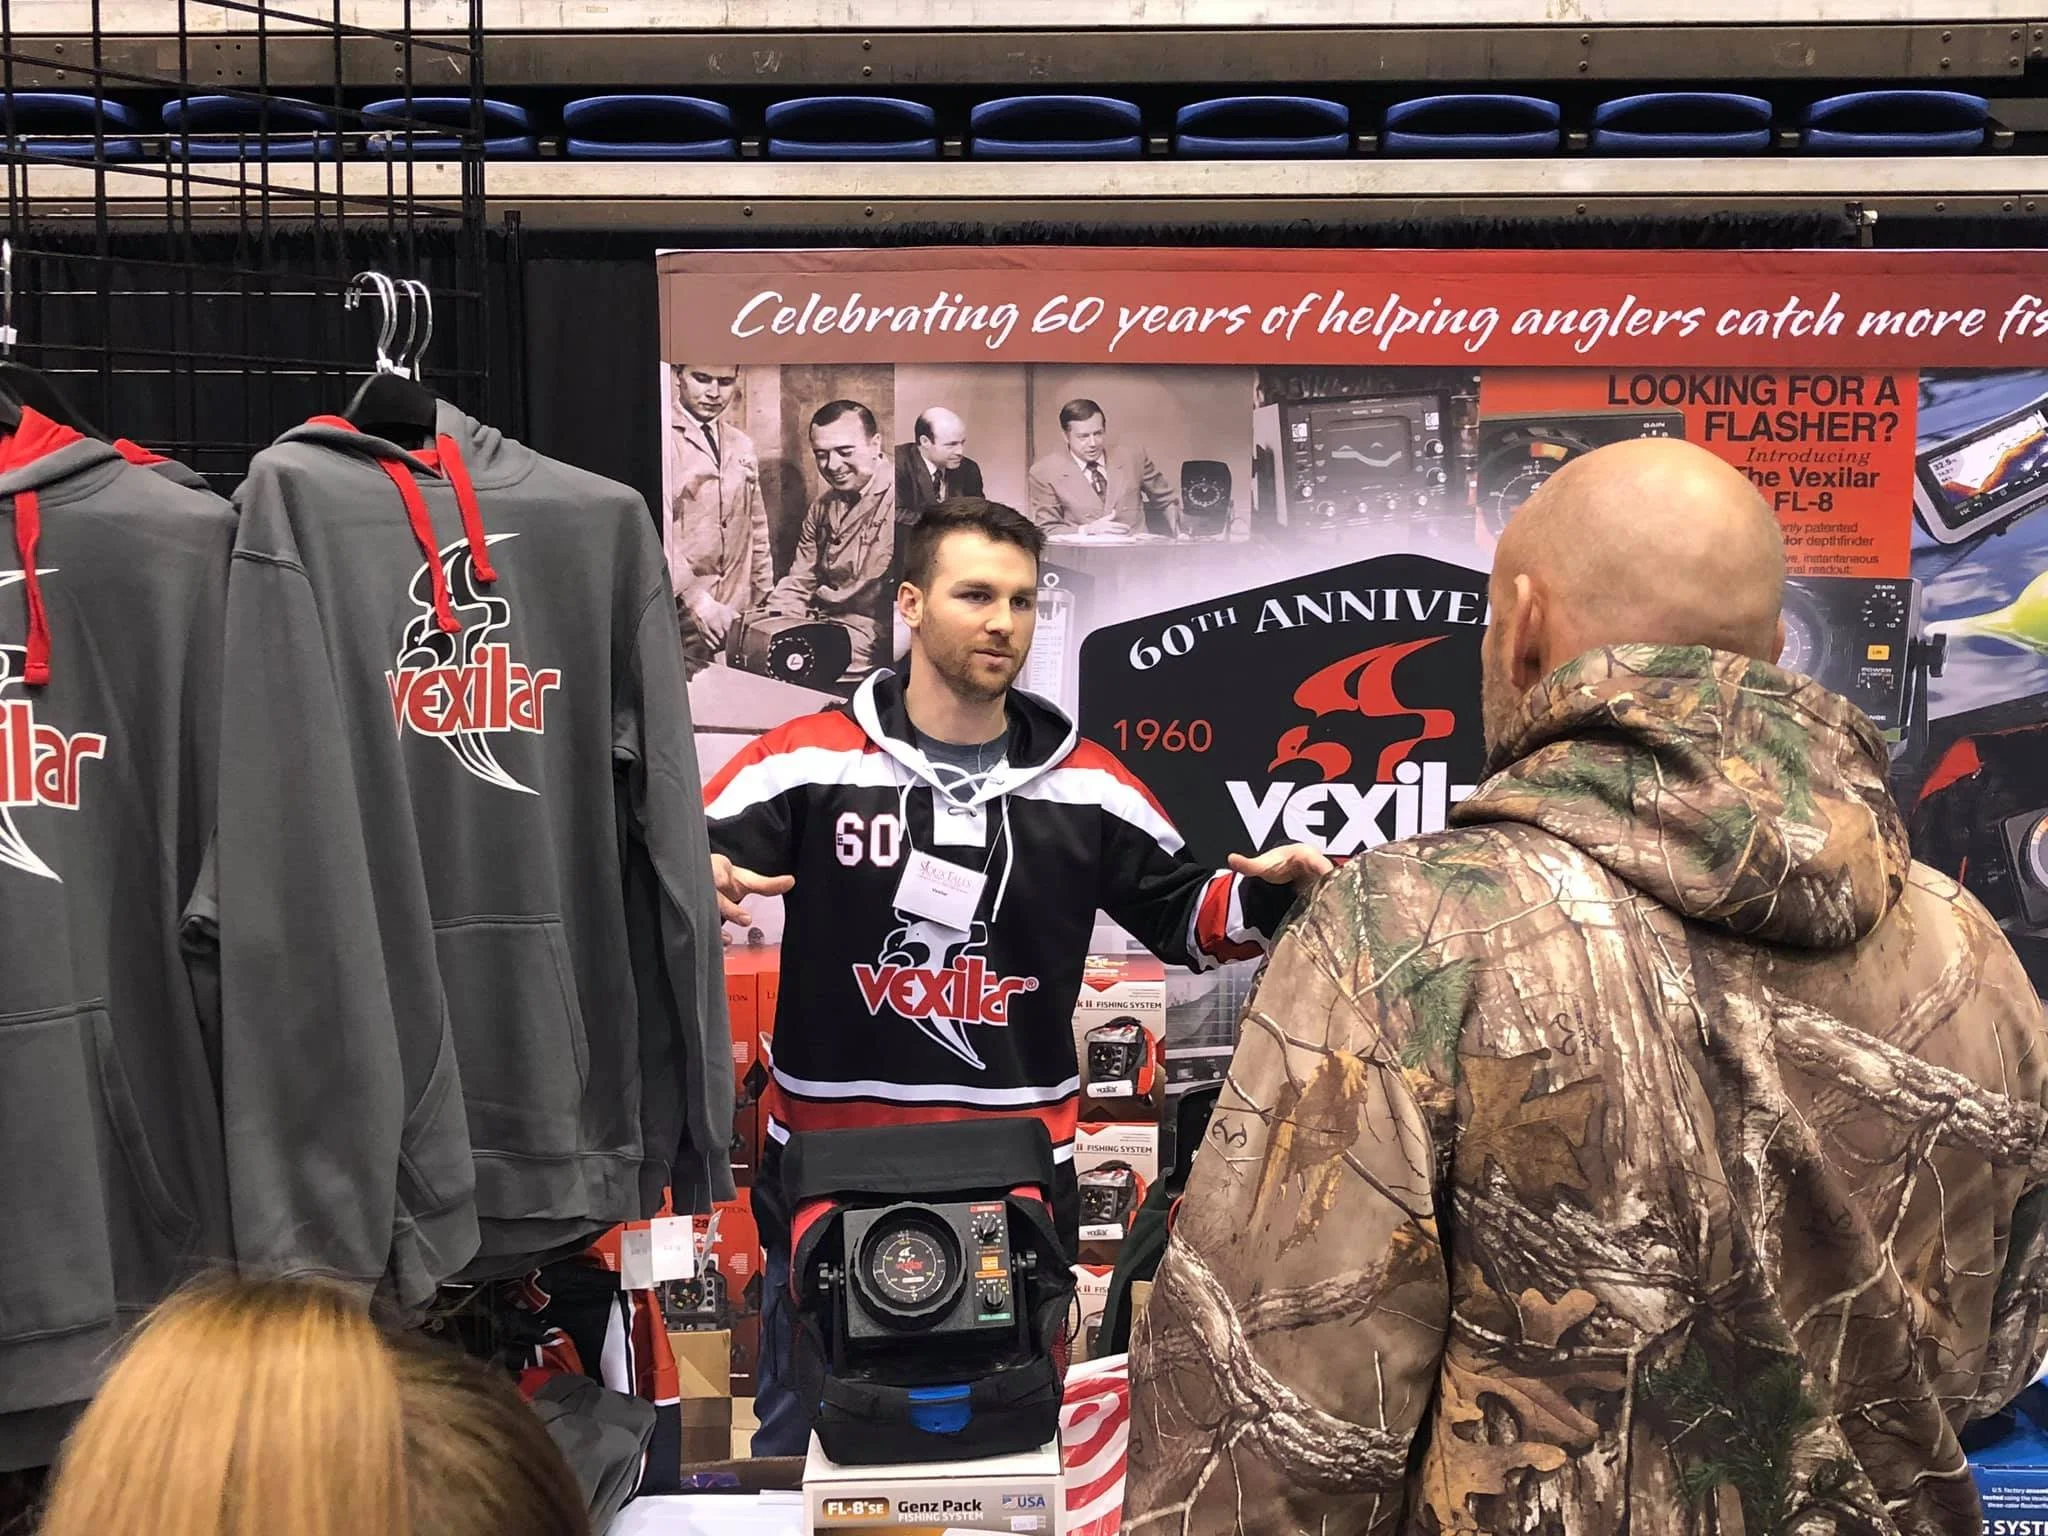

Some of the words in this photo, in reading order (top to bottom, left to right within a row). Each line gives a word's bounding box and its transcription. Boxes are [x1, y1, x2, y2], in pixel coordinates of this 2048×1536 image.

[730, 290, 1018, 350] Celebrating
[1031, 295, 1106, 334] 60
[1107, 303, 1248, 352] years
[1261, 291, 1321, 341] of
[1316, 290, 1500, 352] helping
[1511, 295, 1706, 353] anglers
[1716, 290, 1843, 338] catch
[1856, 306, 1986, 338] more
[1607, 374, 1777, 406] LOOKING
[1787, 374, 1864, 406] FOR
[1873, 374, 1901, 406] A
[1704, 411, 1899, 442] FLASHER?
[1746, 447, 1871, 467] Introducing
[1789, 466, 1881, 488] Vexilar
[1774, 491, 1833, 512] FL-8
[1806, 534, 1875, 548] depthfinder
[1129, 606, 1238, 671] 60TH
[1253, 587, 1491, 634] ANNIVE
[1111, 718, 1213, 753] 1960
[1225, 761, 1478, 855] vexil
[835, 811, 900, 867] 60
[1096, 1001, 1129, 1009] FISHING
[1130, 1001, 1162, 1009] SYSTEM
[1087, 1144, 1119, 1153] FISHING
[1120, 1145, 1153, 1153] SYSTEM
[898, 1501, 938, 1512] Genz
[942, 1499, 982, 1512] Pack
[1018, 1496, 1046, 1508] USA
[898, 1512, 941, 1522] FISHING
[942, 1511, 984, 1521] SYSTEM
